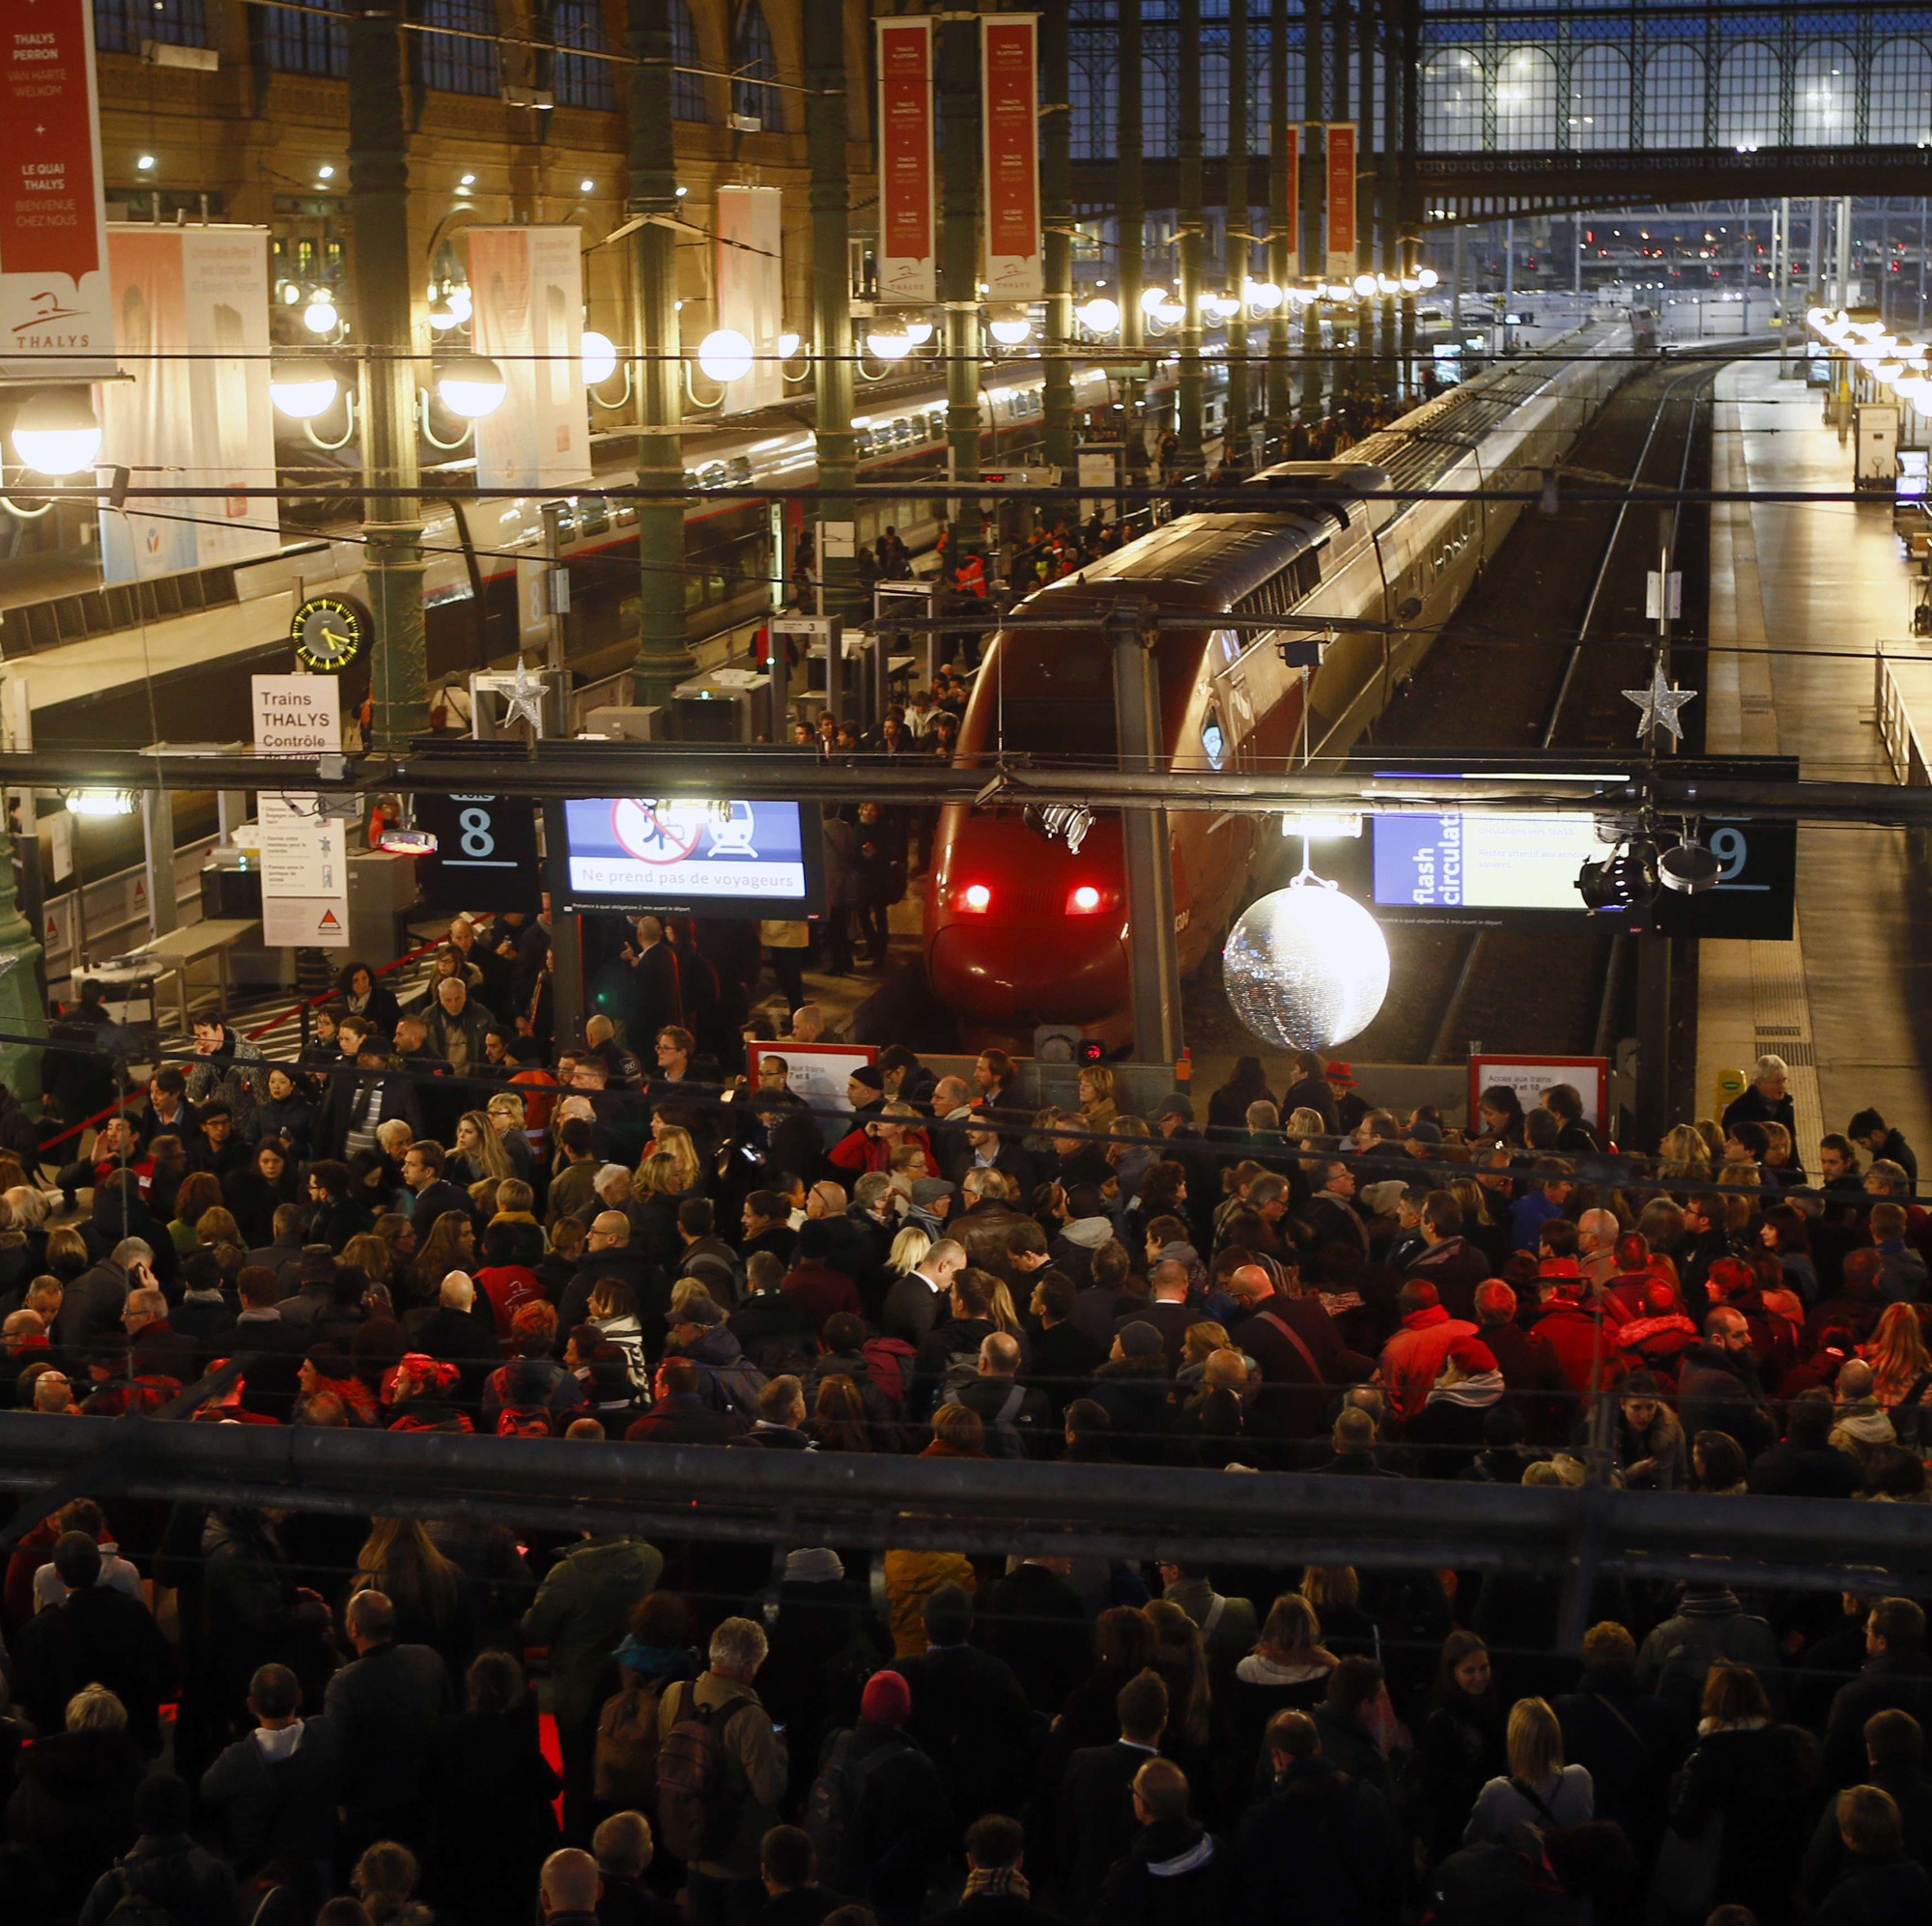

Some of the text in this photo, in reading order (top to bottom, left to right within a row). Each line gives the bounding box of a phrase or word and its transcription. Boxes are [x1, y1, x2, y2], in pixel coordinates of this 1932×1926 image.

[14, 33, 56, 45] THALYS
[13, 49, 58, 61] PERRON
[21, 163, 65, 176] LE QUAI
[24, 179, 66, 190] THALYS
[15, 199, 76, 212] BIENVENUE
[15, 214, 77, 228] CHEZ NOUS
[16, 334, 89, 349] THALYS
[809, 623, 815, 632] 3
[261, 692, 312, 706] Trains
[262, 713, 330, 727] THALYS
[263, 734, 326, 748] Contrôle
[460, 807, 495, 857] 8
[1437, 812, 1461, 905] circulat
[1710, 827, 1747, 880] 9
[582, 868, 794, 890] Ne prend pas de voyageurs
[1412, 848, 1435, 905] flash
[1489, 1074, 1512, 1083] Accès
